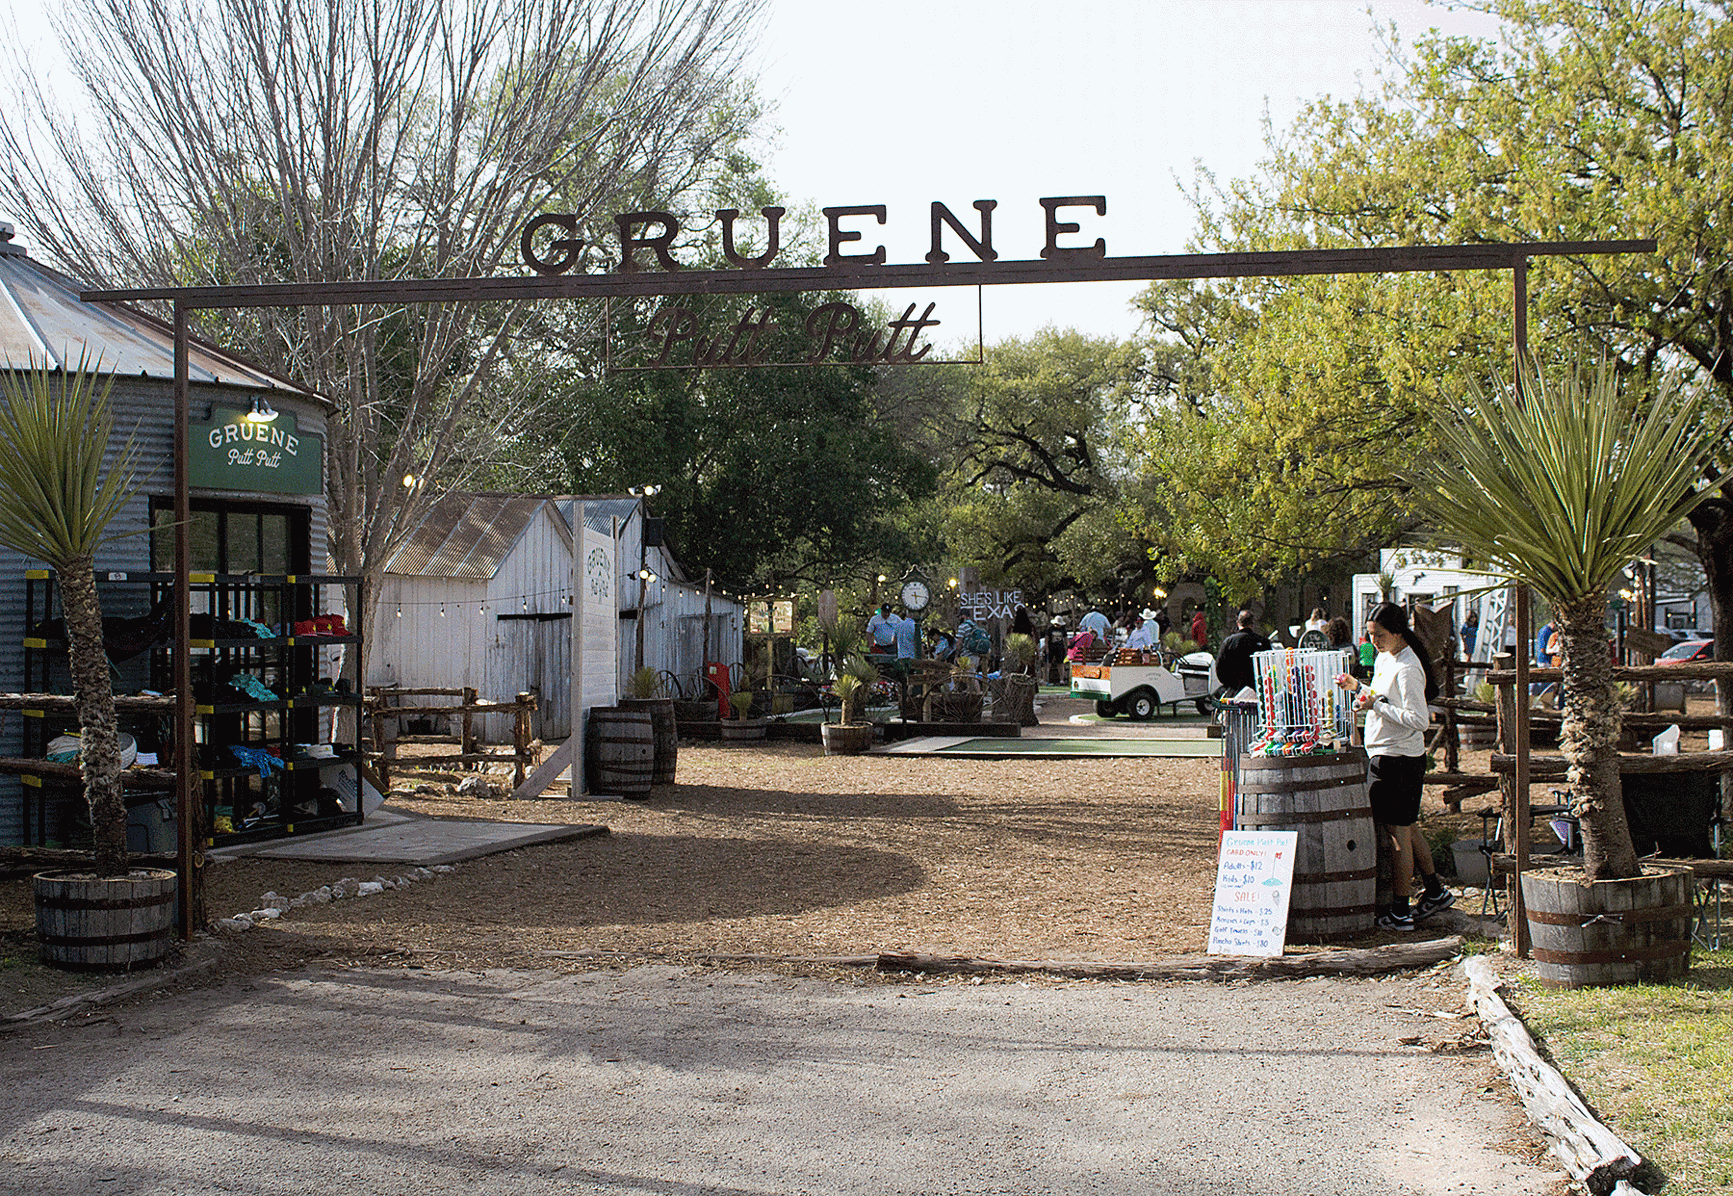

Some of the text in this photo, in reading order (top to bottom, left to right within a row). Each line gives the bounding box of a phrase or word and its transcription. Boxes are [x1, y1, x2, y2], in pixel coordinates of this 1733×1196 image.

[520, 195, 1107, 274] GRUENE
[649, 301, 941, 368] Putt Putt
[208, 422, 299, 457] GRUENE
[227, 448, 281, 469] Putt Putt
[960, 590, 1022, 606] SHE'S LIKE
[1226, 848, 1244, 856] CARD
[1222, 874, 1238, 883] Kids
[1242, 874, 1255, 885] $10
